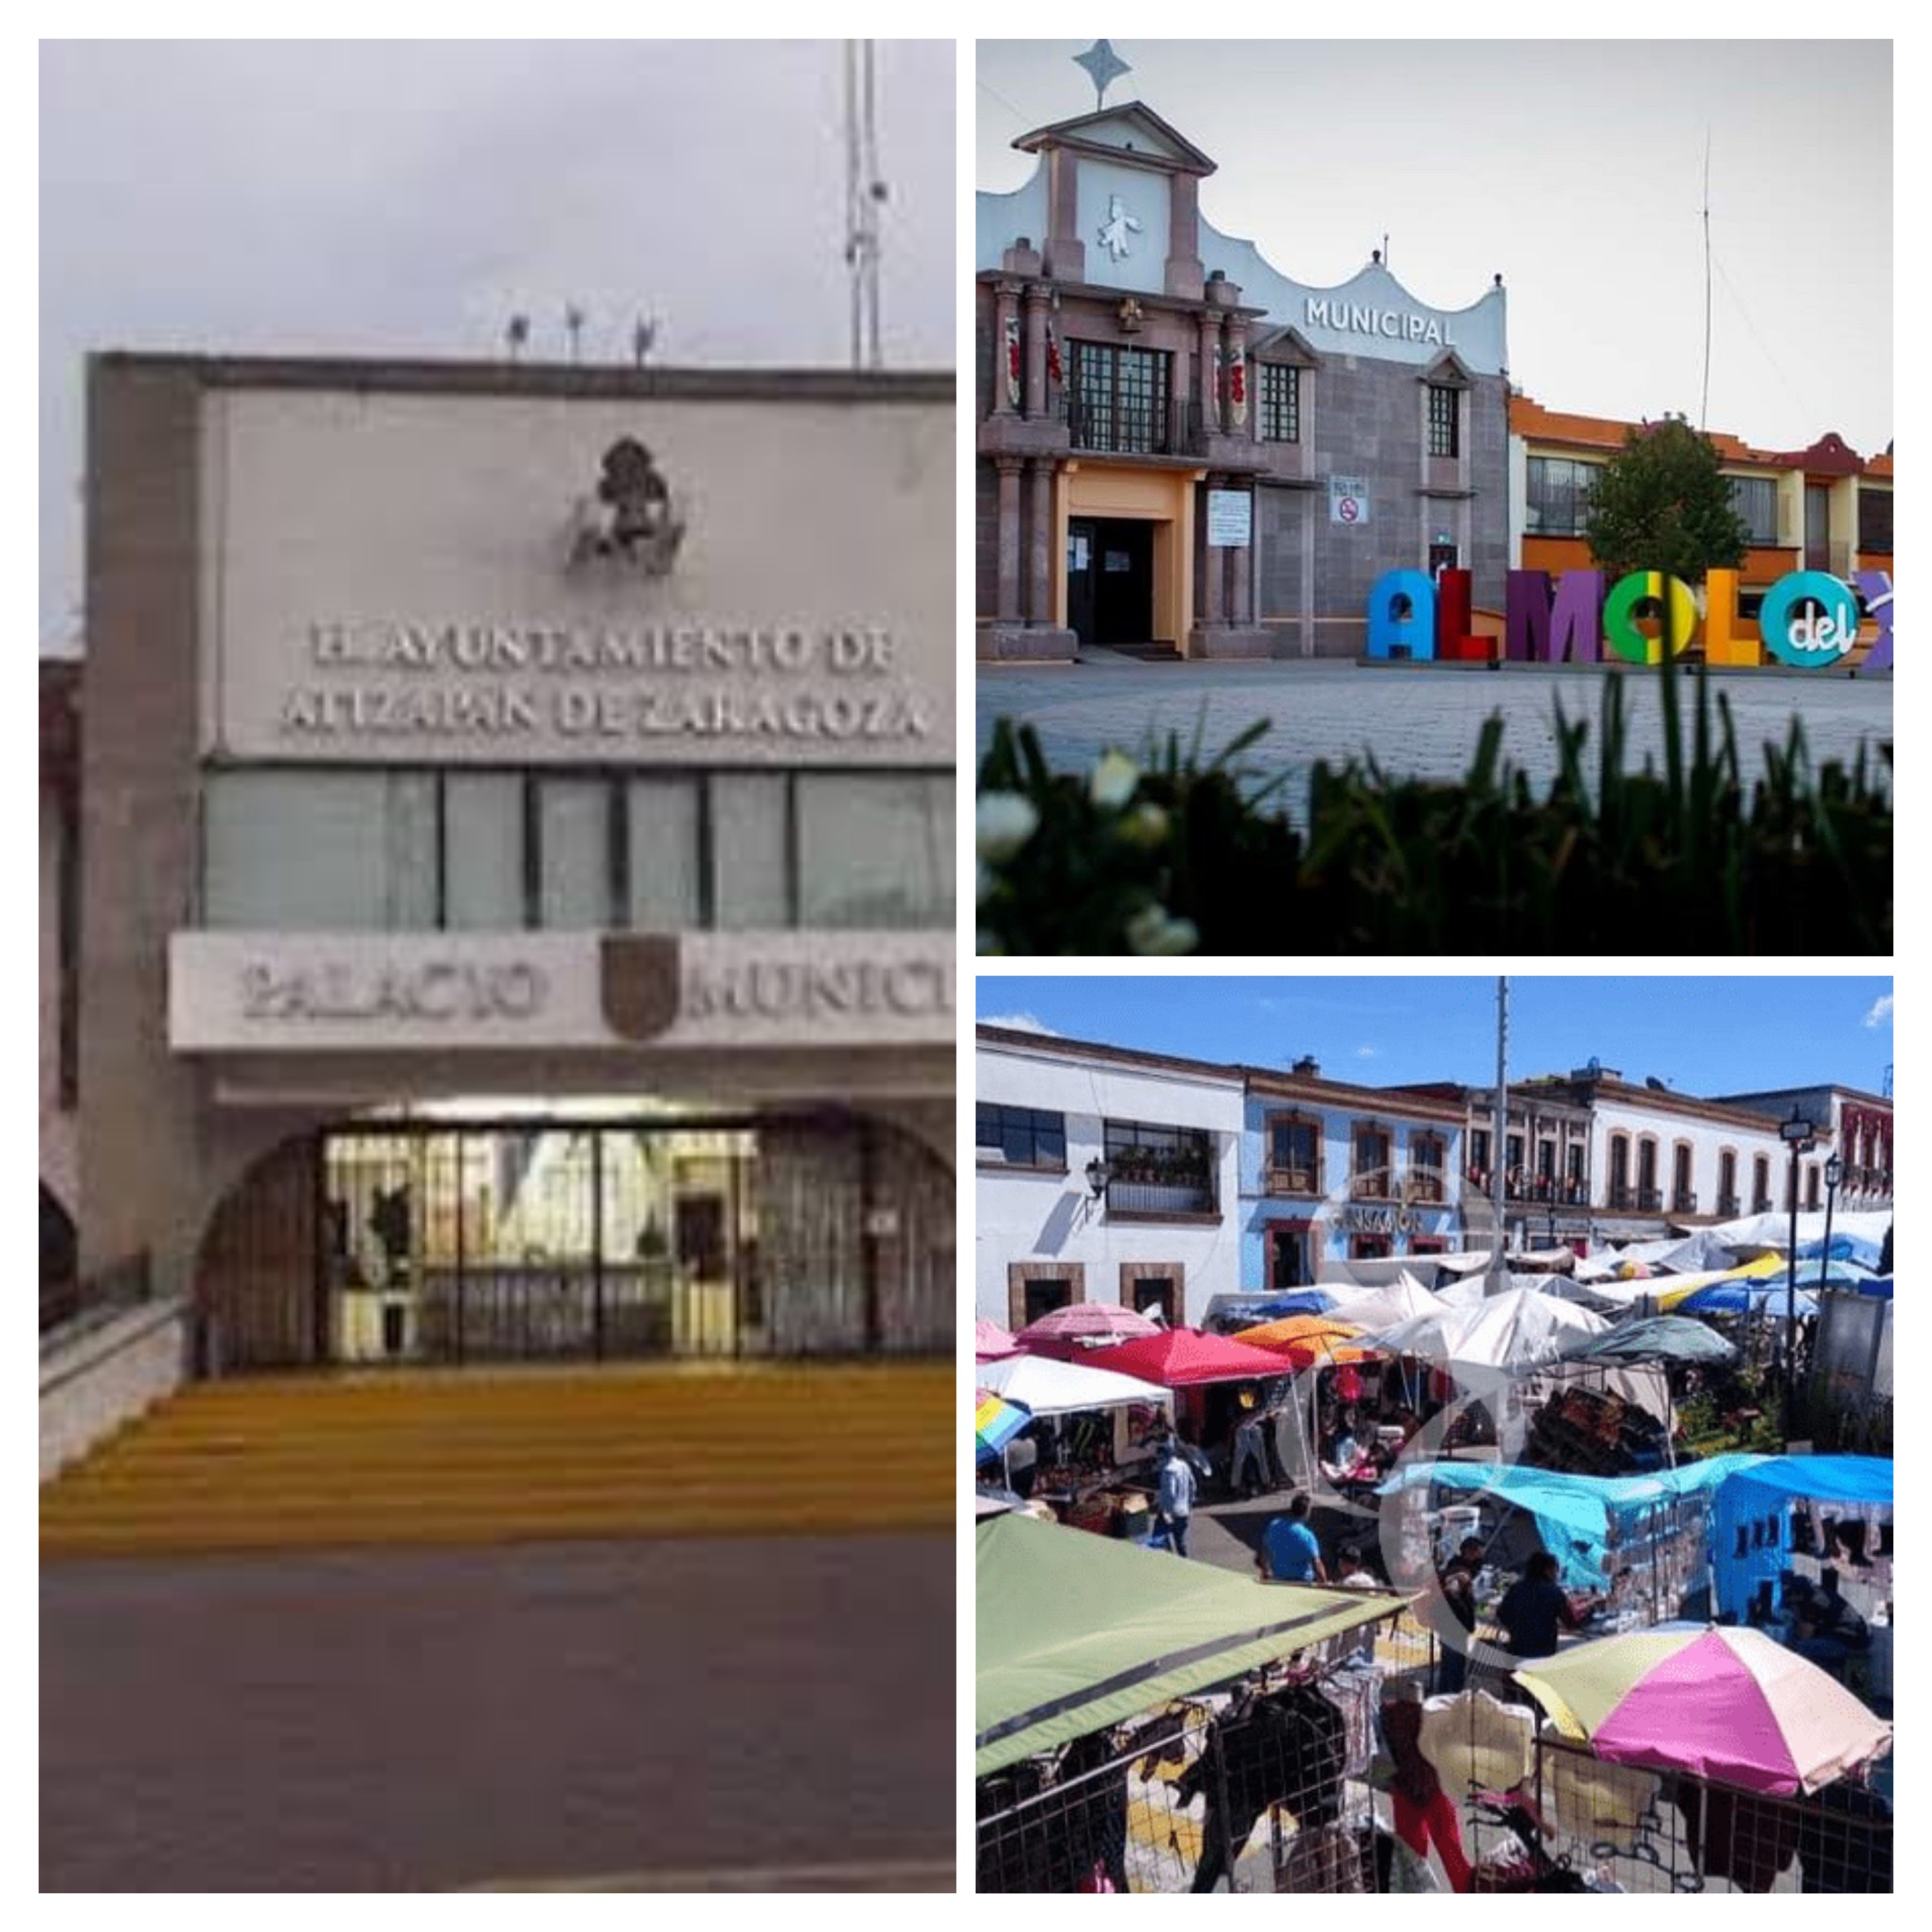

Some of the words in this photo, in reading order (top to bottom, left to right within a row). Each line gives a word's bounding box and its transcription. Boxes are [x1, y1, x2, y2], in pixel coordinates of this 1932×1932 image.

[1305, 298, 1458, 347] MUNICIPAL
[384, 623, 813, 671] AYUNTAMIENTO
[826, 625, 894, 674] DE
[1788, 600, 1857, 653] del
[554, 687, 629, 736] DE
[635, 690, 931, 742] ZARAGOZA
[241, 962, 551, 1020] PALACIO
